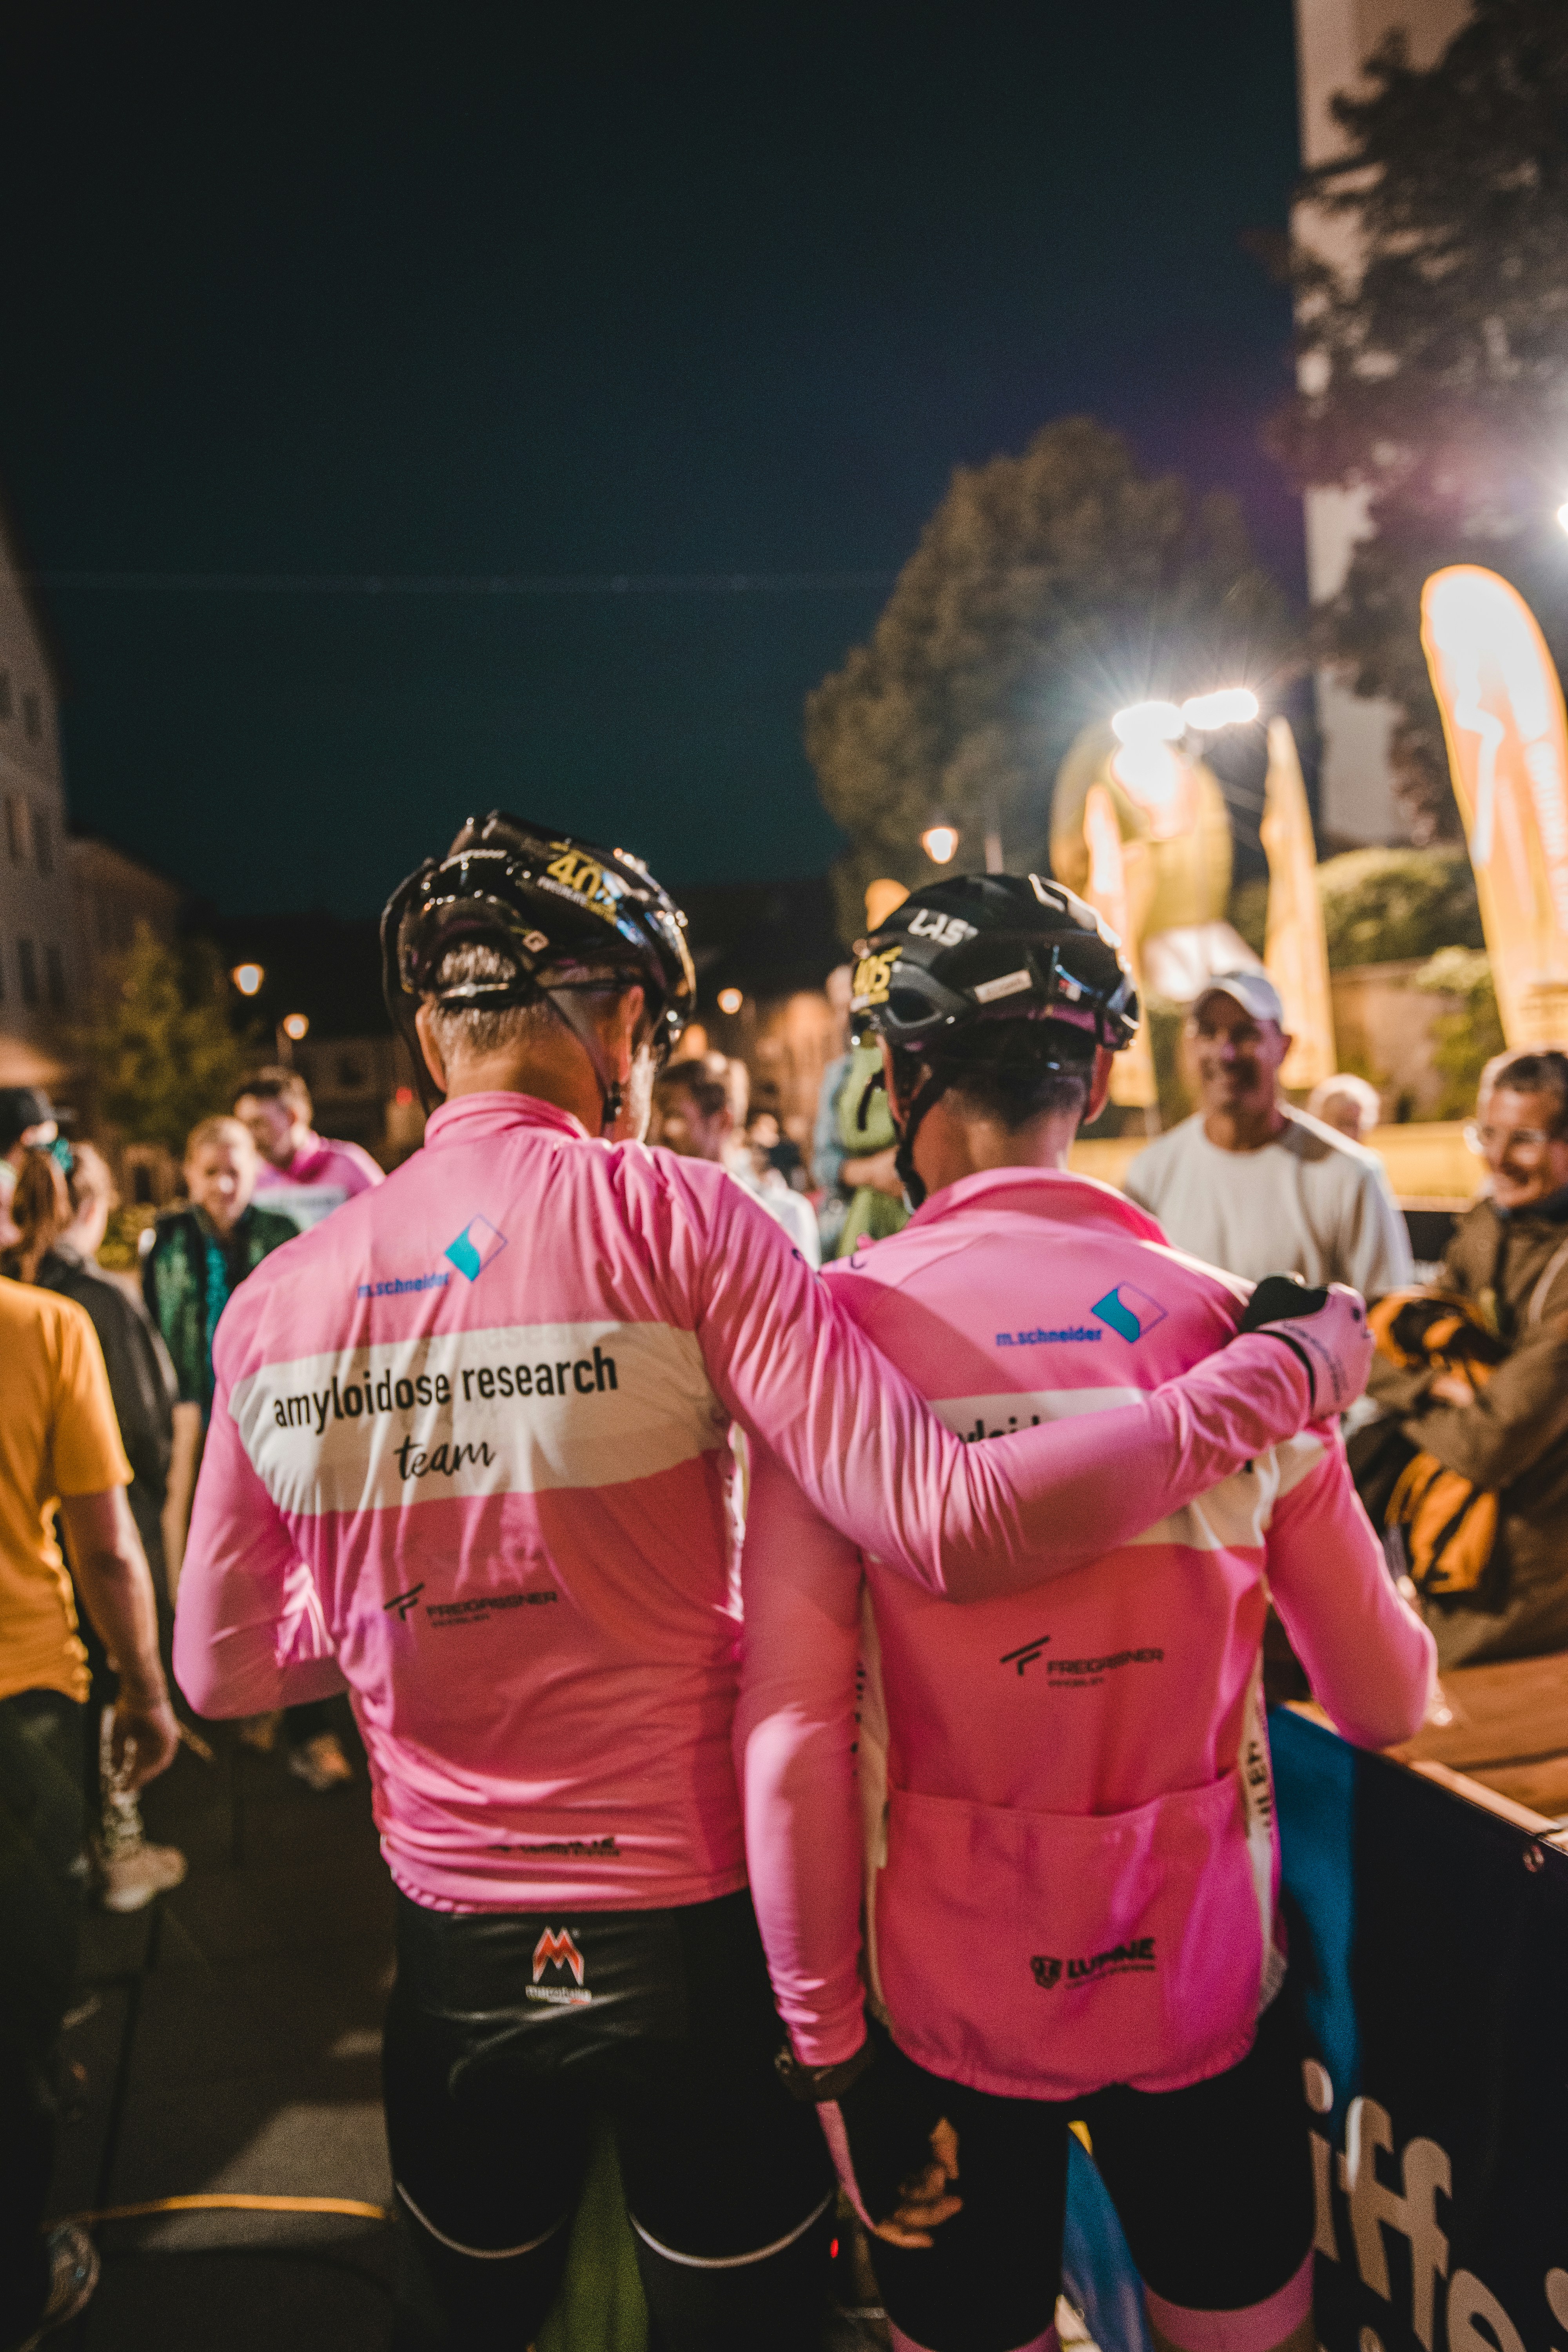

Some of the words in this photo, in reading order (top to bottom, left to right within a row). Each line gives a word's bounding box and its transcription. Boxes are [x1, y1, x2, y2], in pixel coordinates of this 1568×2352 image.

[358, 1272, 449, 1298] m.schneider
[996, 1326, 1102, 1346] m.schneider
[273, 1369, 452, 1435] amyloidose
[463, 1346, 618, 1401] research
[394, 1435, 495, 1480] team
